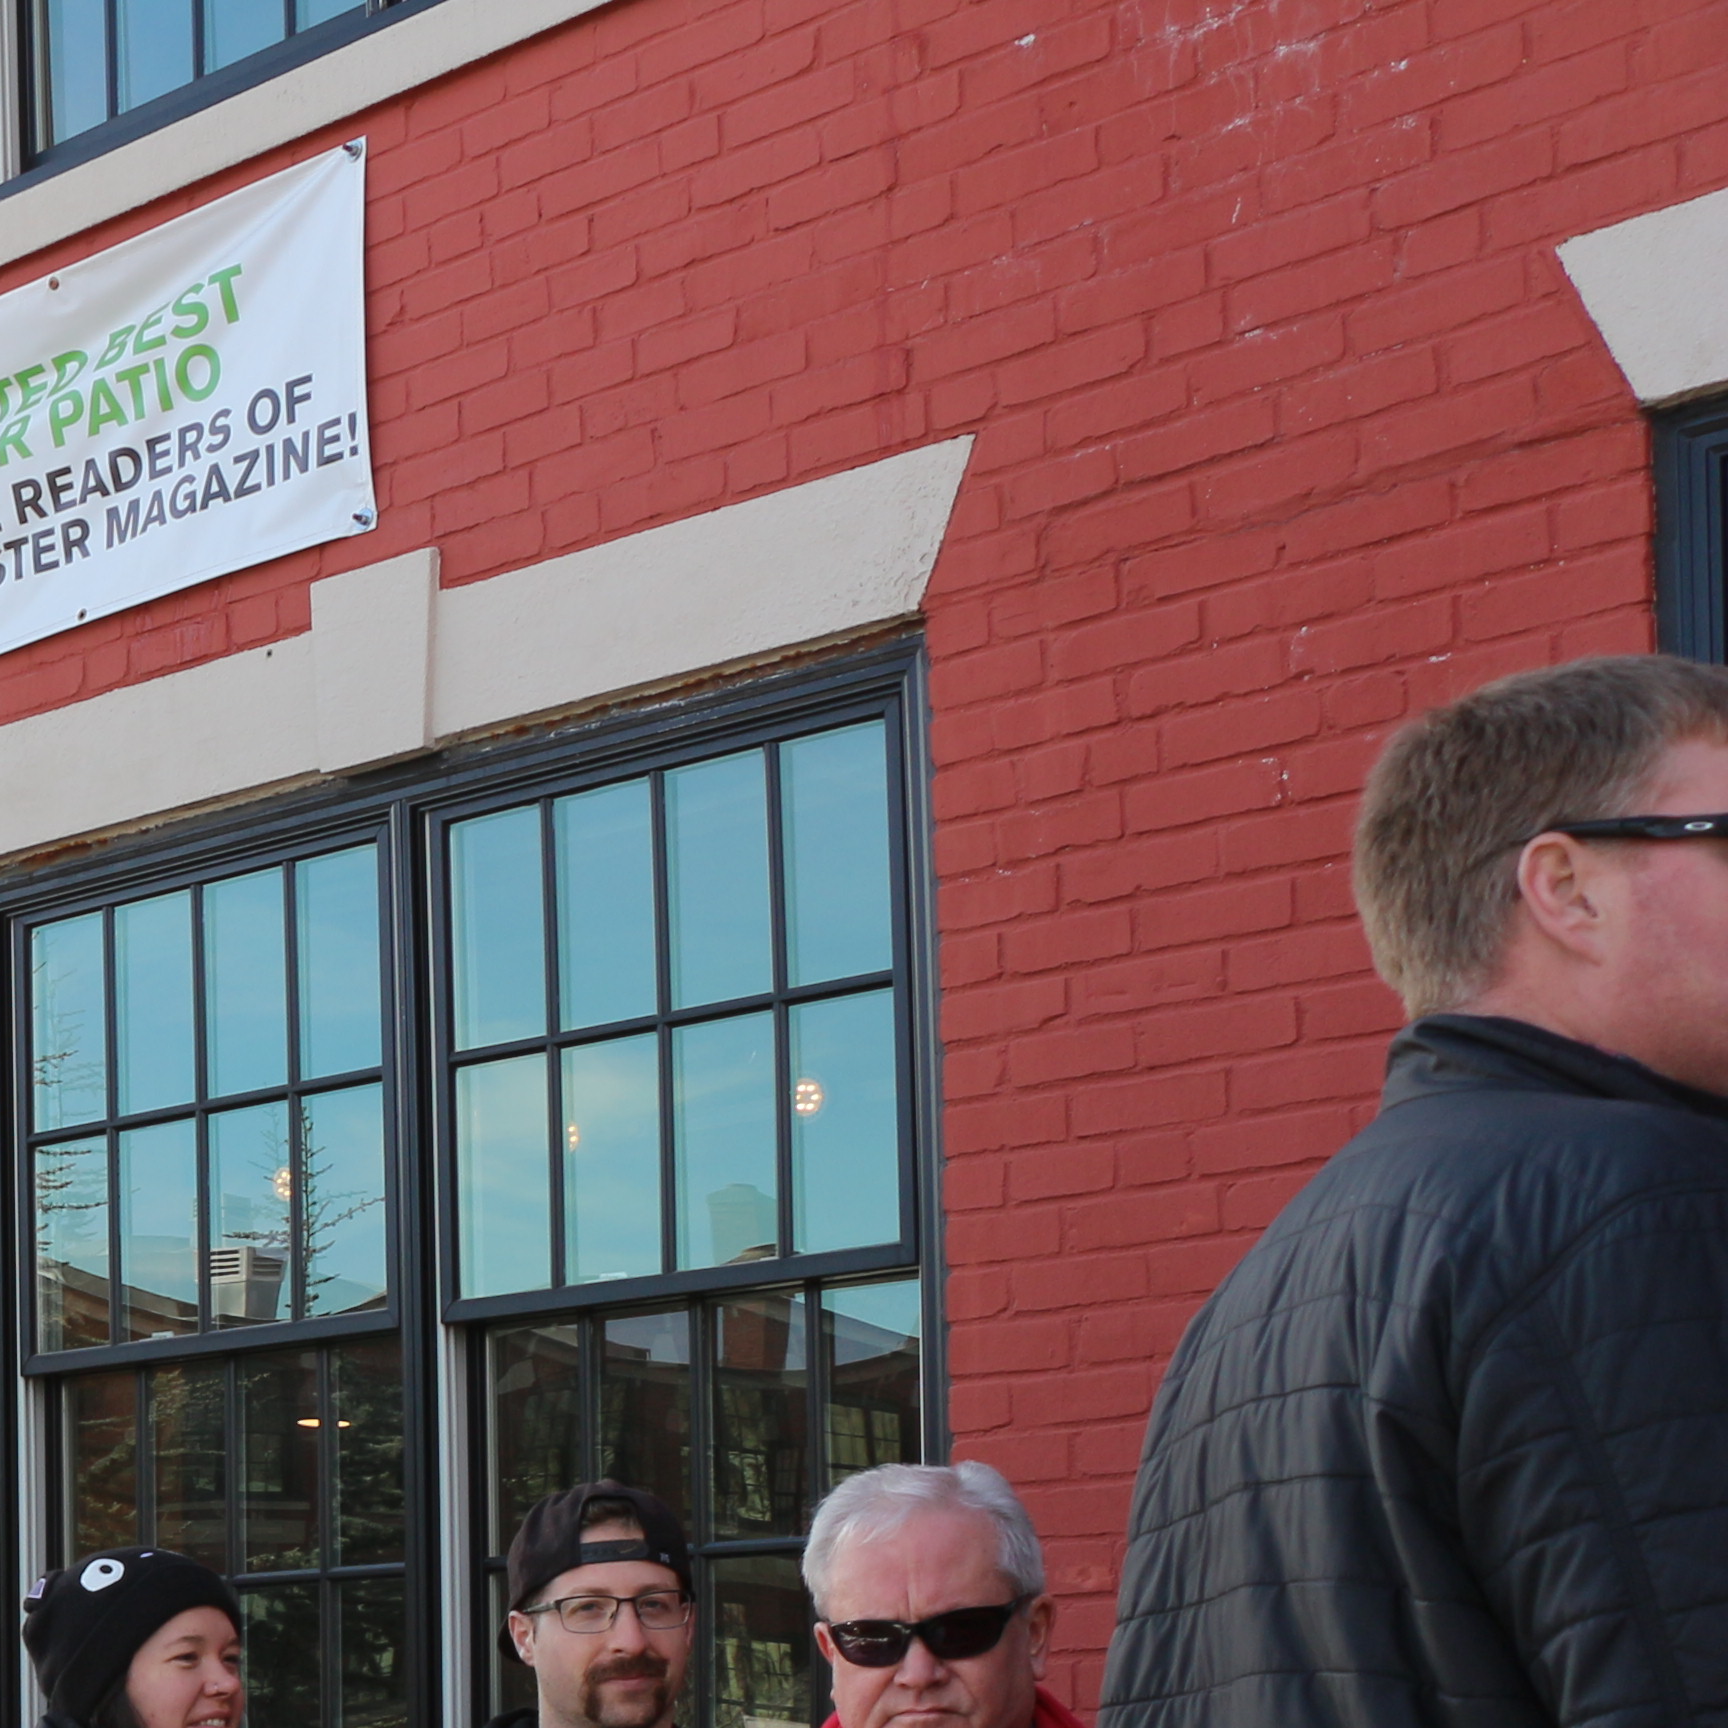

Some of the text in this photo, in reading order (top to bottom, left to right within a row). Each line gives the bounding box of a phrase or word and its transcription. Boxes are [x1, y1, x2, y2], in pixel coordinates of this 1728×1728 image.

[93, 263, 243, 372] BEST
[12, 408, 233, 525] READERS
[247, 373, 314, 436] OF
[49, 343, 221, 448] PATIO
[105, 411, 360, 550] MAGAZINE!
